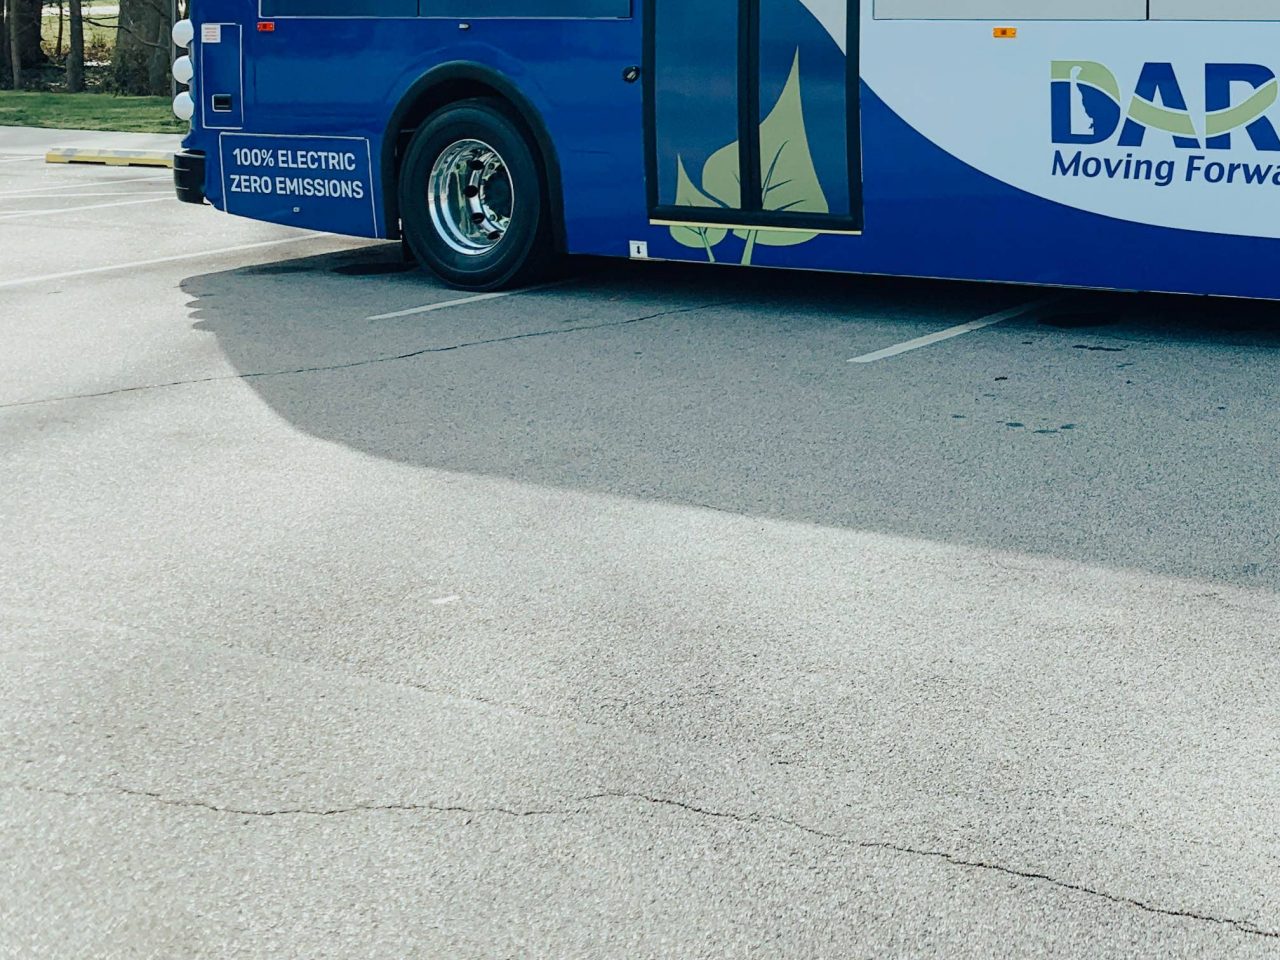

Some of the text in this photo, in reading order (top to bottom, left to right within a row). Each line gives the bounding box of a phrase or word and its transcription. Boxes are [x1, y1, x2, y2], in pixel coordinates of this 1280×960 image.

[232, 148, 356, 171] 100% ELECTRIC
[1051, 150, 1175, 187] Moving
[230, 174, 364, 199] ZERO EMISSIONS
